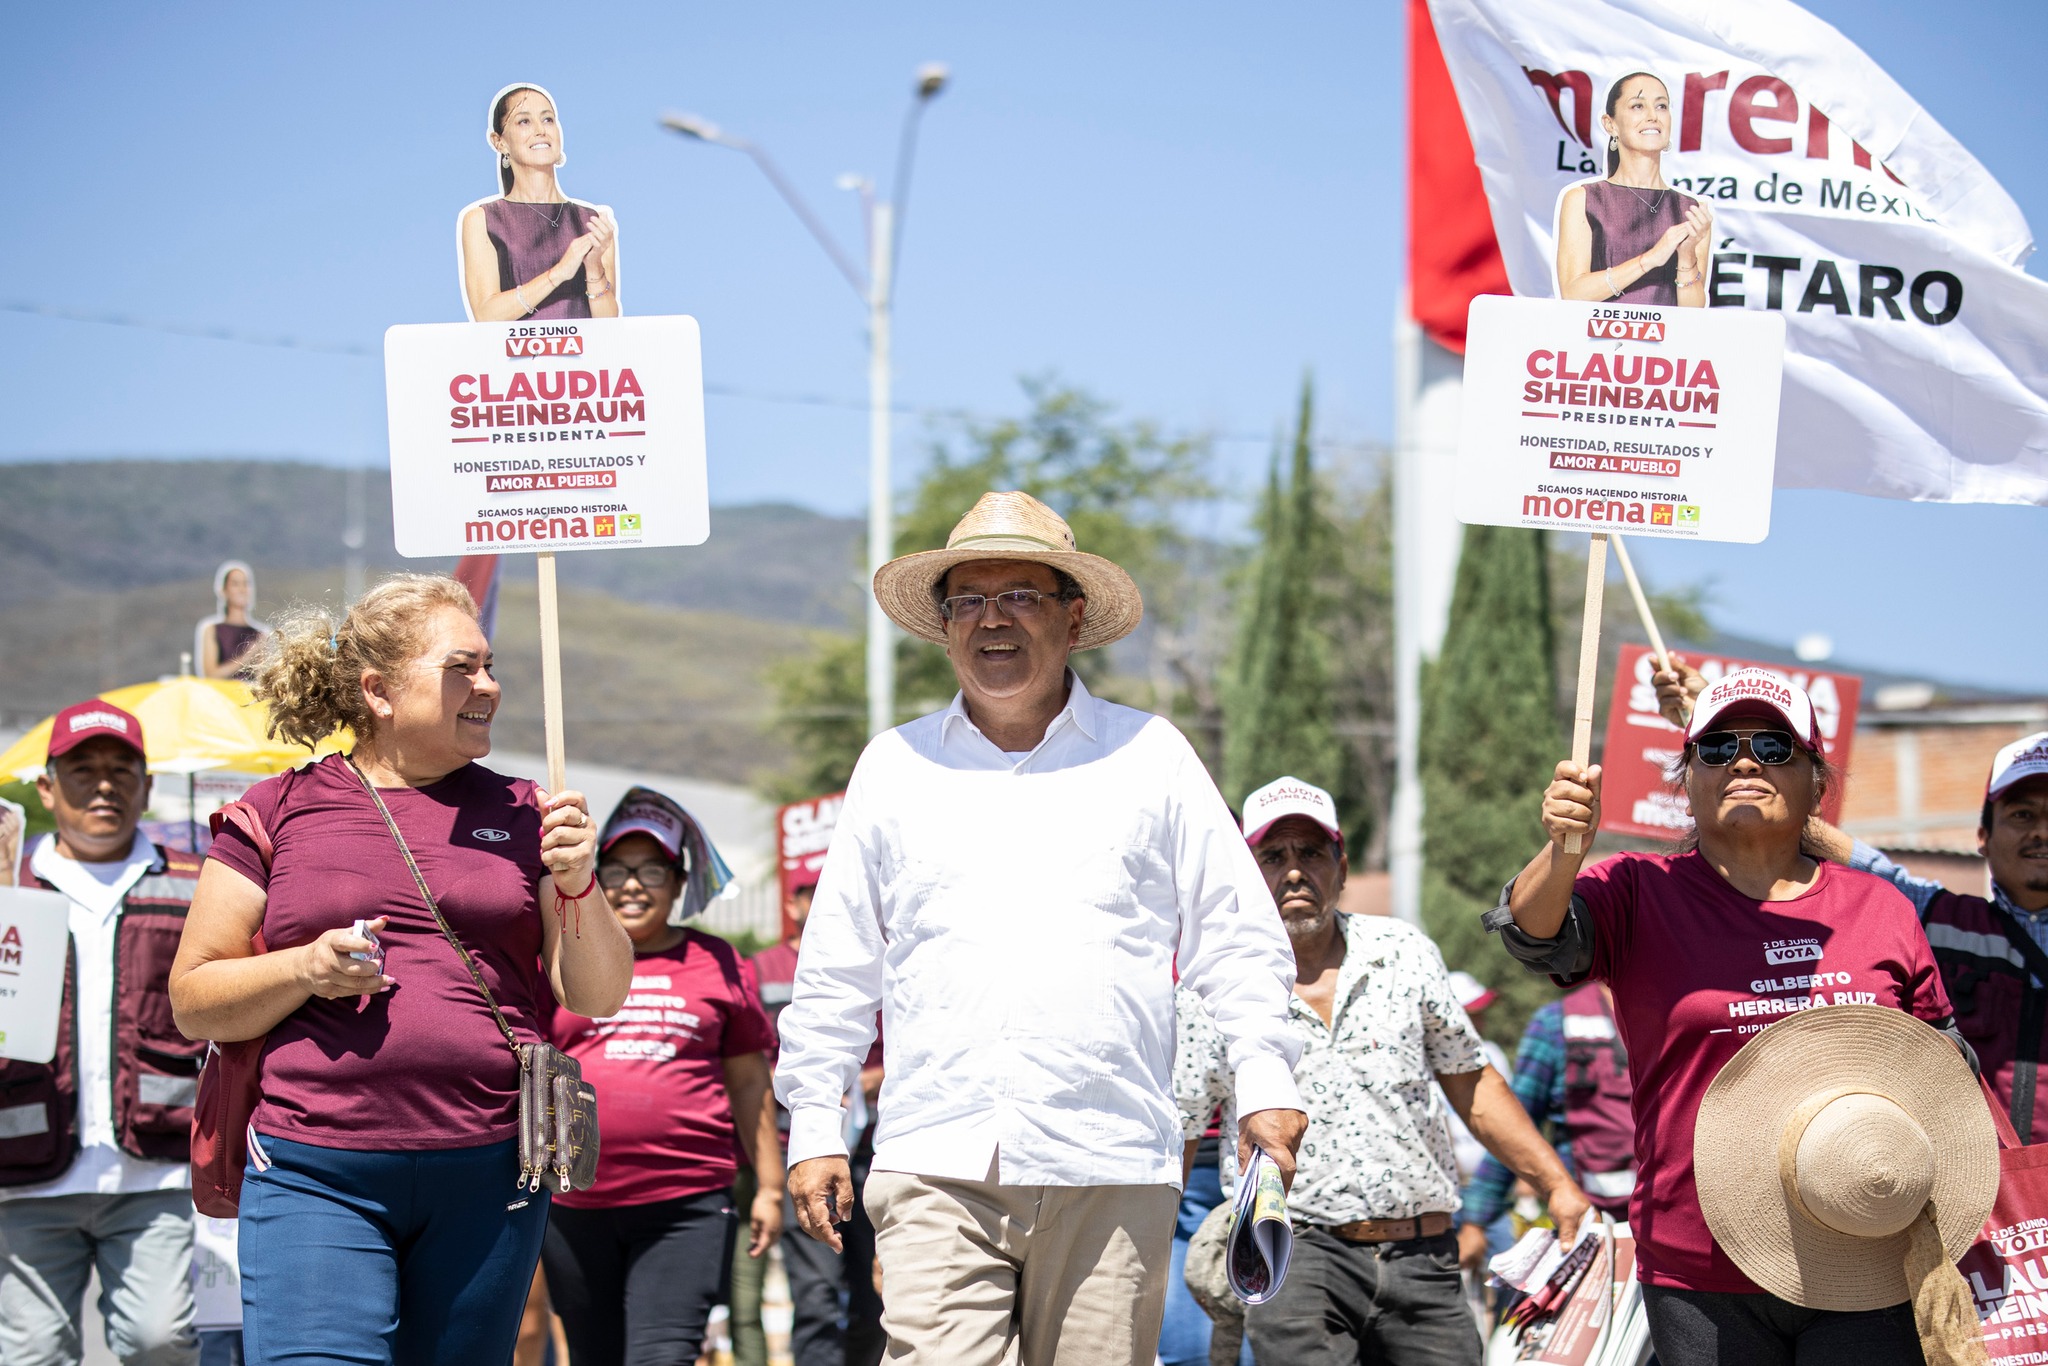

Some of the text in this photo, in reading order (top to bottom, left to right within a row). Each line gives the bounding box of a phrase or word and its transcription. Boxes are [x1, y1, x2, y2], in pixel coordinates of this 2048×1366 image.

[1754, 172, 1803, 205] de
[1593, 309, 1662, 322] 2 DE JUNIO
[508, 326, 578, 337] 2 DE JUNIO
[1589, 319, 1663, 340] VOTA
[507, 337, 582, 356] VOTA
[1526, 349, 1720, 390] CLAUDIA
[449, 368, 644, 404] CLAUDIA
[1522, 380, 1719, 415] SHEINBAUM
[449, 399, 645, 429] SHEINBAUM
[1562, 410, 1676, 429] PRESIDENTA
[492, 429, 606, 444] PRESIDENTA
[1520, 435, 1714, 459] HONESTIDAD, RESULTADOS Y
[453, 454, 646, 474] HONESTIDAD, RESULTADOS Y
[1553, 454, 1678, 475] AMOR AL PUEBLO
[490, 474, 614, 491] AMOR AL PUEBLO
[1537, 484, 1688, 502] SIGAMOS HACIENDO HISTORIA
[477, 503, 628, 518] SIGAMOS HACIENDO HISTORIA
[1522, 495, 1646, 524] morena
[1653, 511, 1672, 524] PT
[465, 516, 589, 542] morena
[595, 524, 614, 536] PT
[1561, 521, 1592, 529] PRESIDENTA
[1710, 688, 1792, 708] SHEINBAUM
[1711, 678, 1792, 700] CLAUDIA
[1259, 787, 1323, 802] CLAUDIA
[1771, 940, 1786, 948] DE
[1788, 938, 1819, 946] JUNIO
[1773, 947, 1815, 960] VOTA
[1750, 971, 1852, 994] GILBERTO
[1728, 991, 1877, 1018] HERRERA RUIZ
[1990, 1217, 2048, 1239] 2 DE JUNIO
